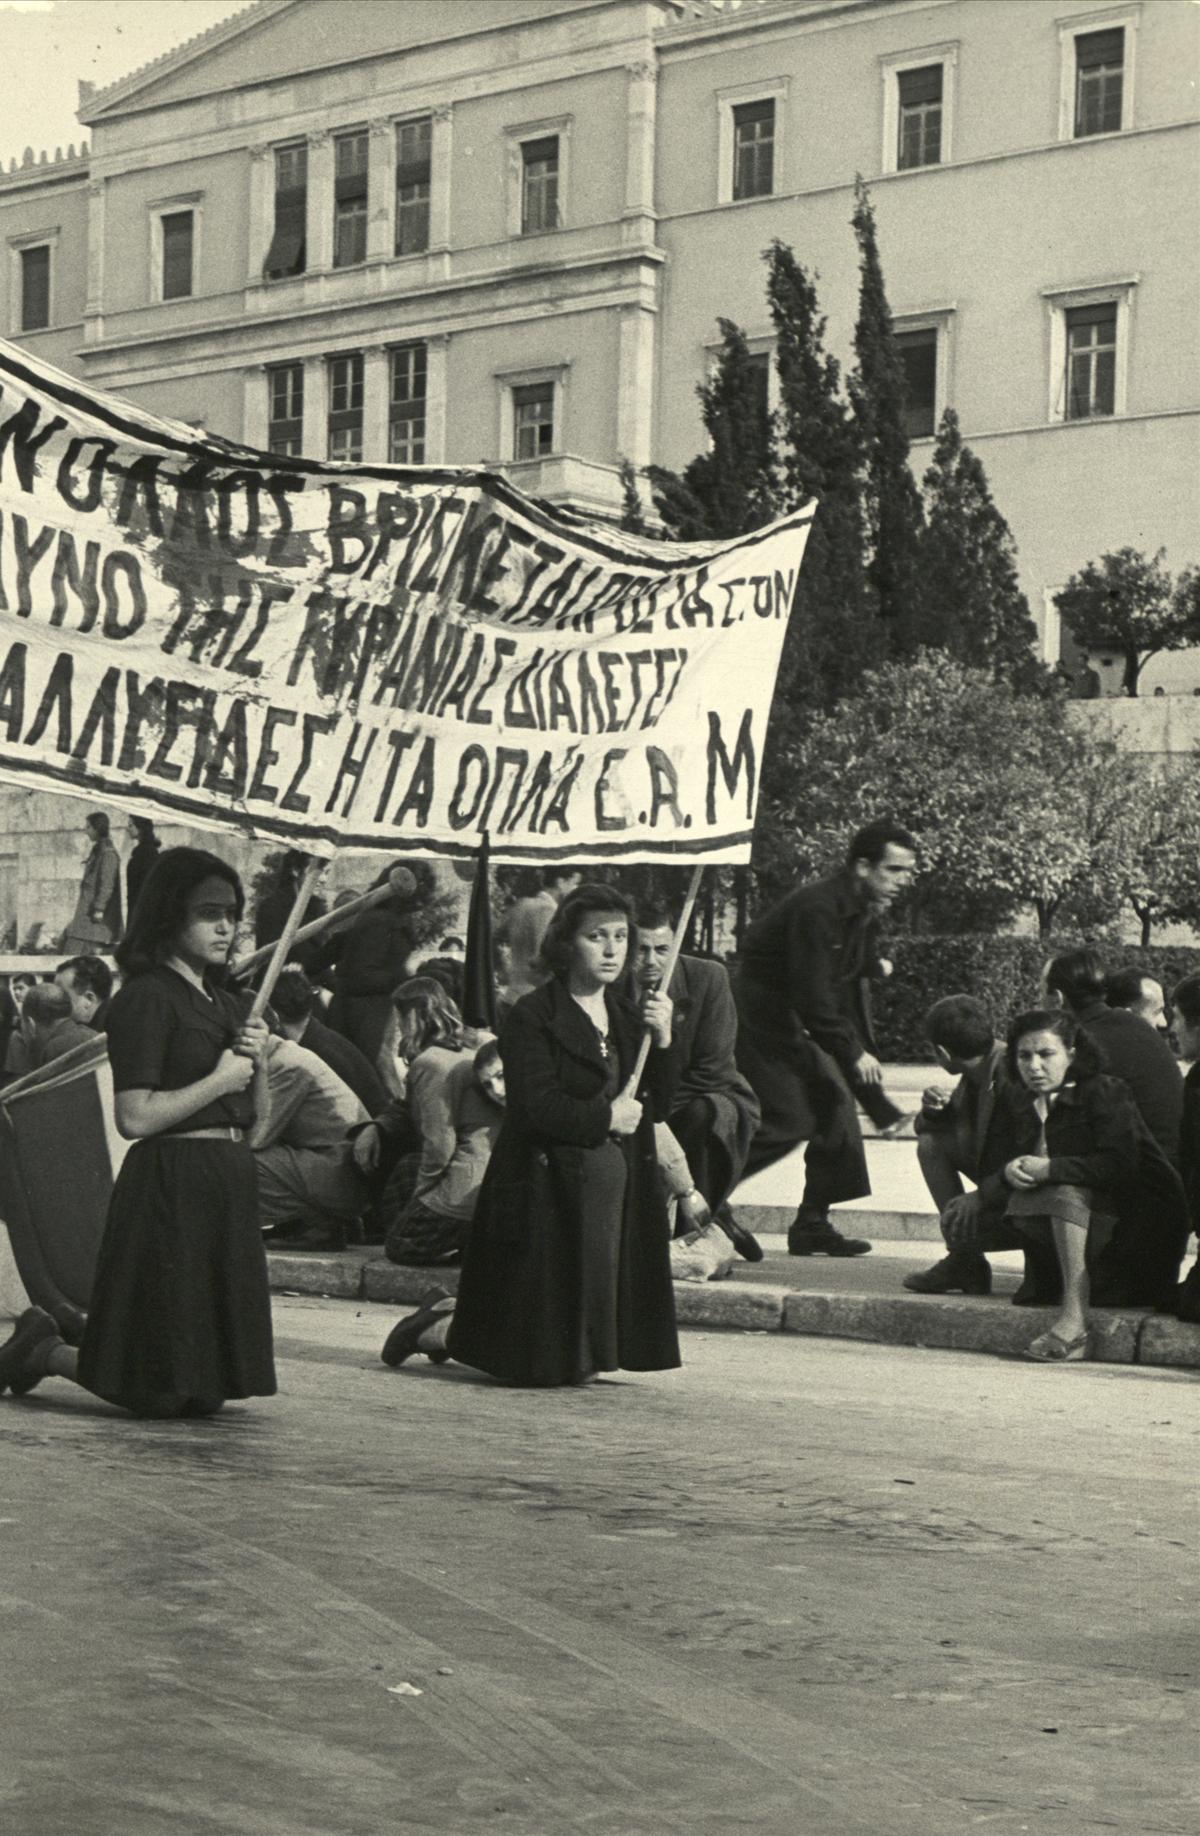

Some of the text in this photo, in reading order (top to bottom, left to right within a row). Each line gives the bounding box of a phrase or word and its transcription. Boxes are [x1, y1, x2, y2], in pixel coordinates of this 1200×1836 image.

[56, 436, 118, 513] Ο
[326, 483, 604, 628] ΒΡΙΣΚΕΤΑΙ
[504, 647, 689, 735] ΔΙΑΛΕΓΕΙ
[324, 722, 379, 818] Η
[373, 728, 436, 829] ΤΑ
[448, 743, 585, 834] ΟΠΛΑ
